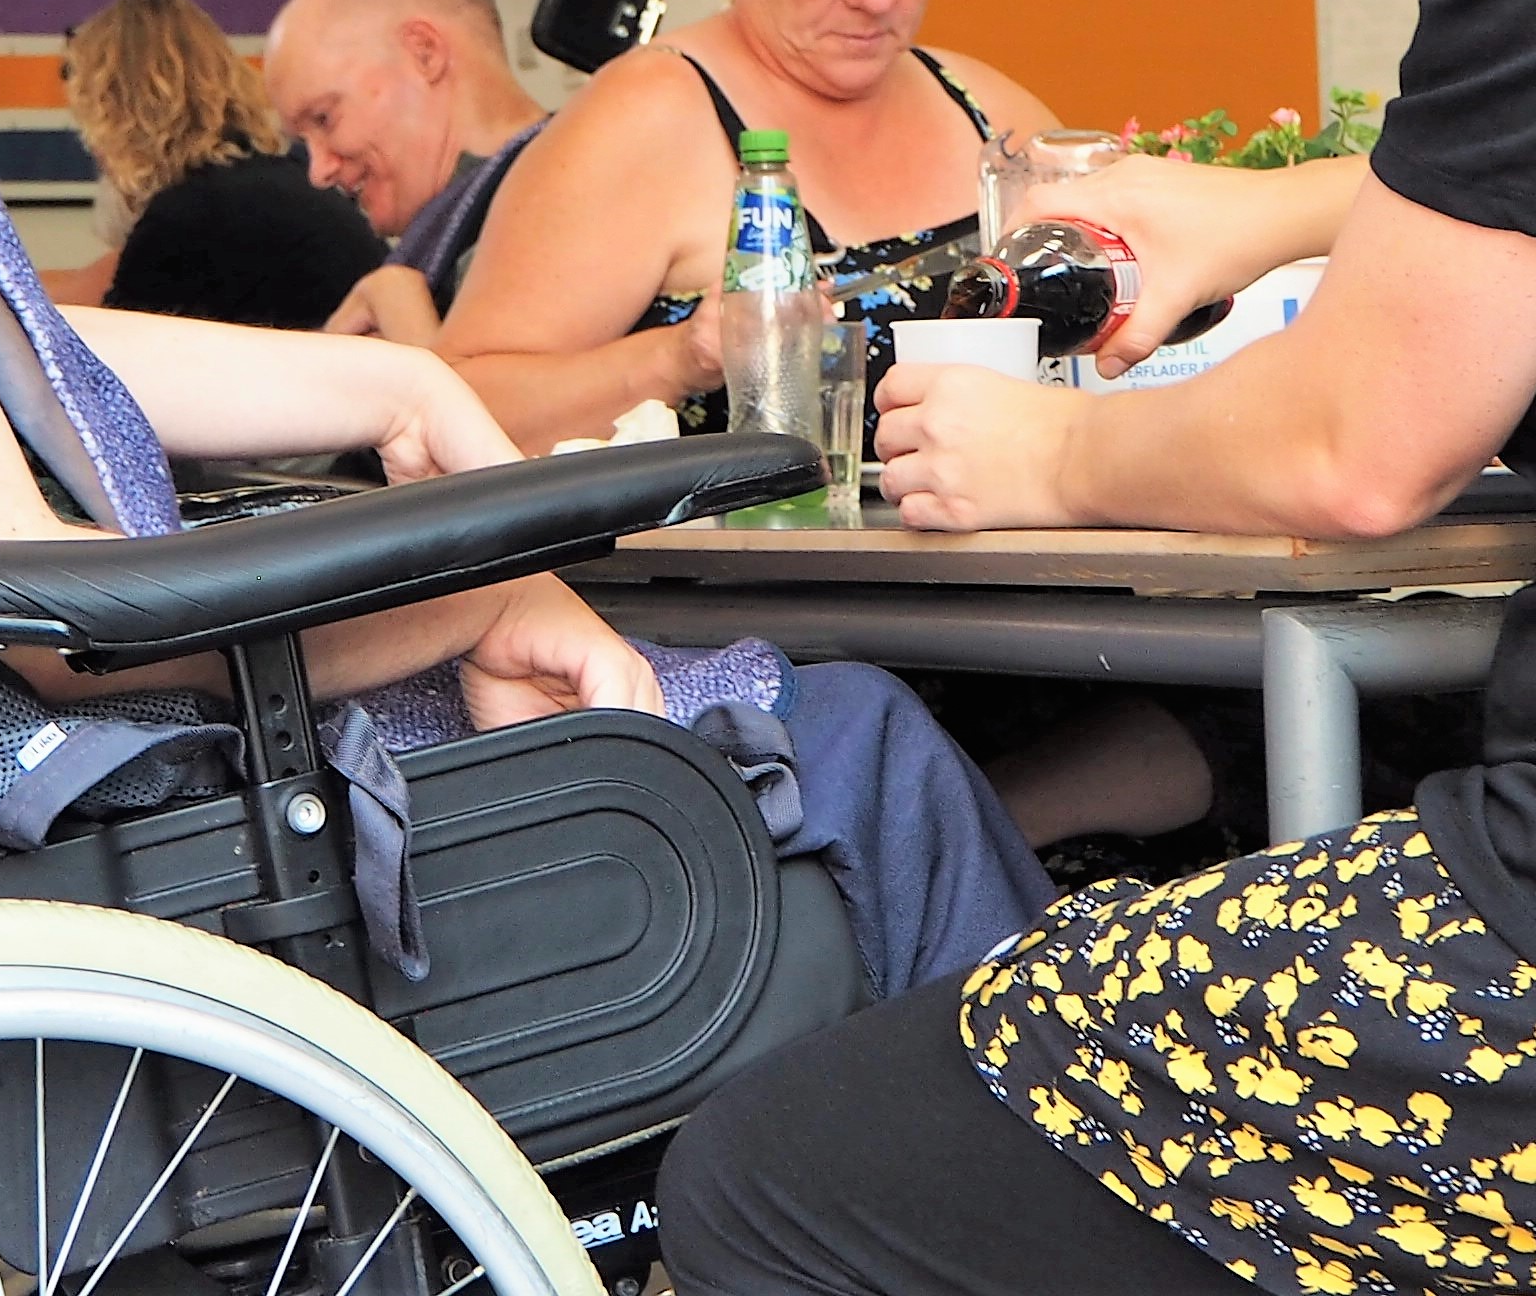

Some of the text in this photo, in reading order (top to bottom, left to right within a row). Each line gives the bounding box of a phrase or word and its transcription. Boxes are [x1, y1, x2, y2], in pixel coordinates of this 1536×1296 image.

[738, 206, 793, 230] FUN
[1156, 345, 1177, 357] ES
[1122, 362, 1198, 379] ERFLADER
[571, 1211, 623, 1245] ea
